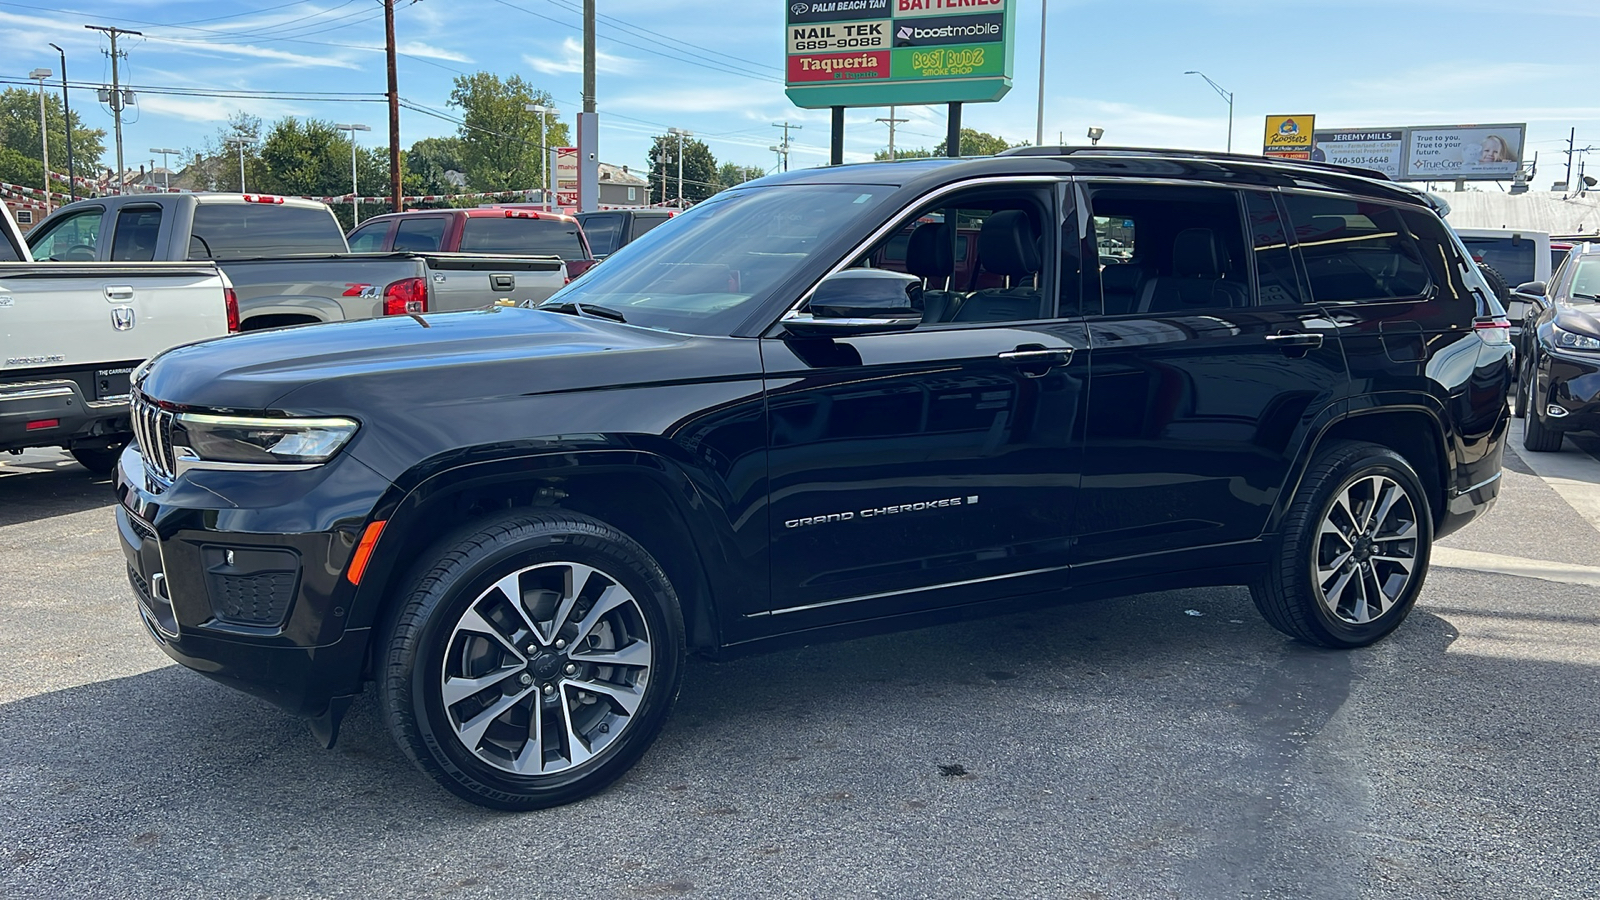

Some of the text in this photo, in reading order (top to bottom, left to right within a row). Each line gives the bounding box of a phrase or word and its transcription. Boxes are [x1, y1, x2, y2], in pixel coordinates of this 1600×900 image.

[812, 0, 886, 12] PALM BEACH TAN
[899, 0, 1001, 11] BATTE
[794, 24, 882, 40] NAIL TEK
[914, 23, 1000, 38] boostmobile
[796, 37, 881, 50] 689-9088
[946, 48, 984, 68] BUDZ
[922, 68, 949, 76] SMOKE
[1270, 133, 1307, 144] Roosters
[1416, 148, 1440, 156] future.
[1423, 159, 1462, 168] TrueCore
[784, 511, 854, 528] GRAND
[860, 497, 962, 518] CHEROKEE
